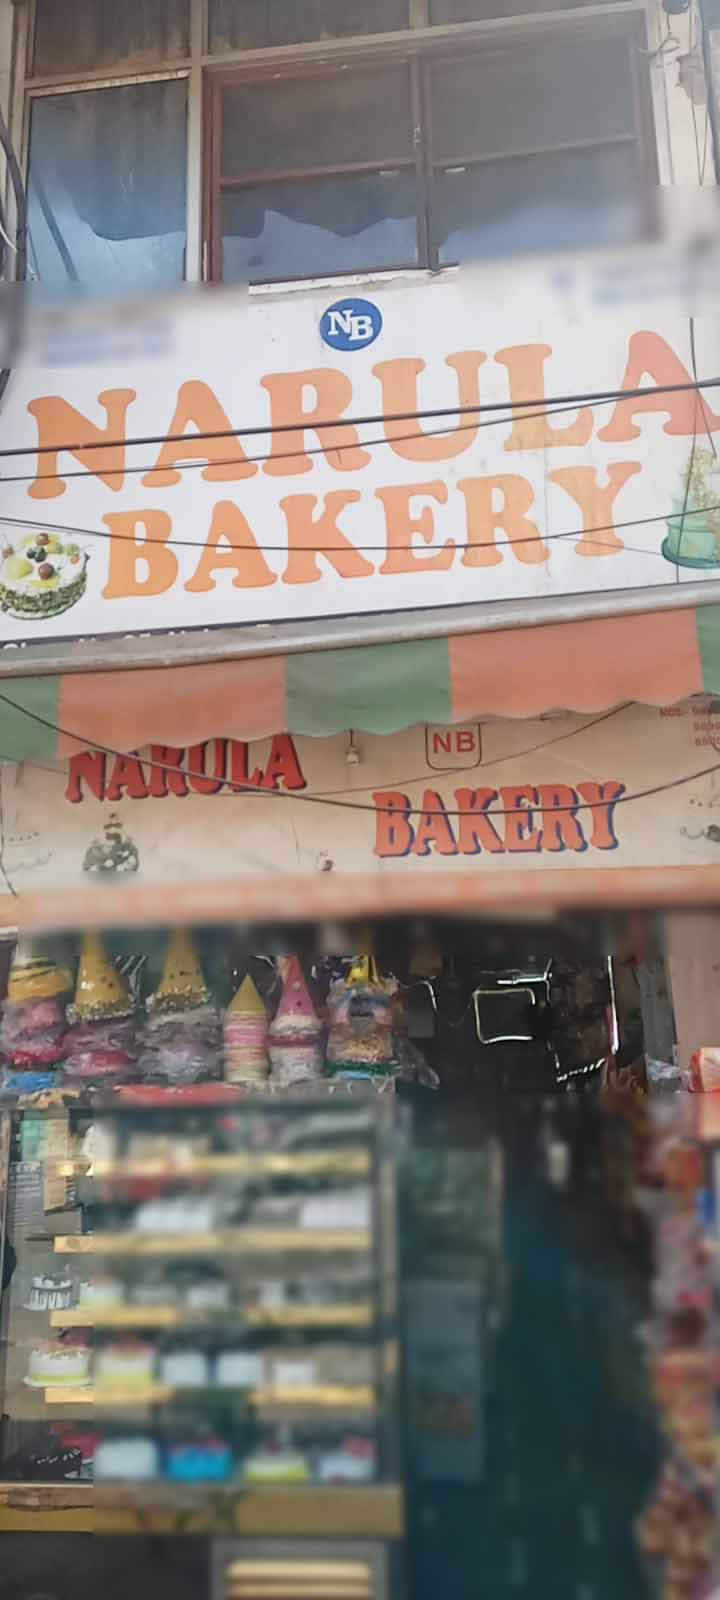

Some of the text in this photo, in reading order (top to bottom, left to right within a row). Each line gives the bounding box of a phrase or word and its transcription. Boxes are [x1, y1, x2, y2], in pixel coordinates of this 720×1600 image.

[327, 309, 374, 341] NB
[27, 330, 720, 500] NARULA
[101, 461, 642, 600] BAKERY
[432, 731, 476, 753] NB
[372, 781, 626, 858] BAKERY
